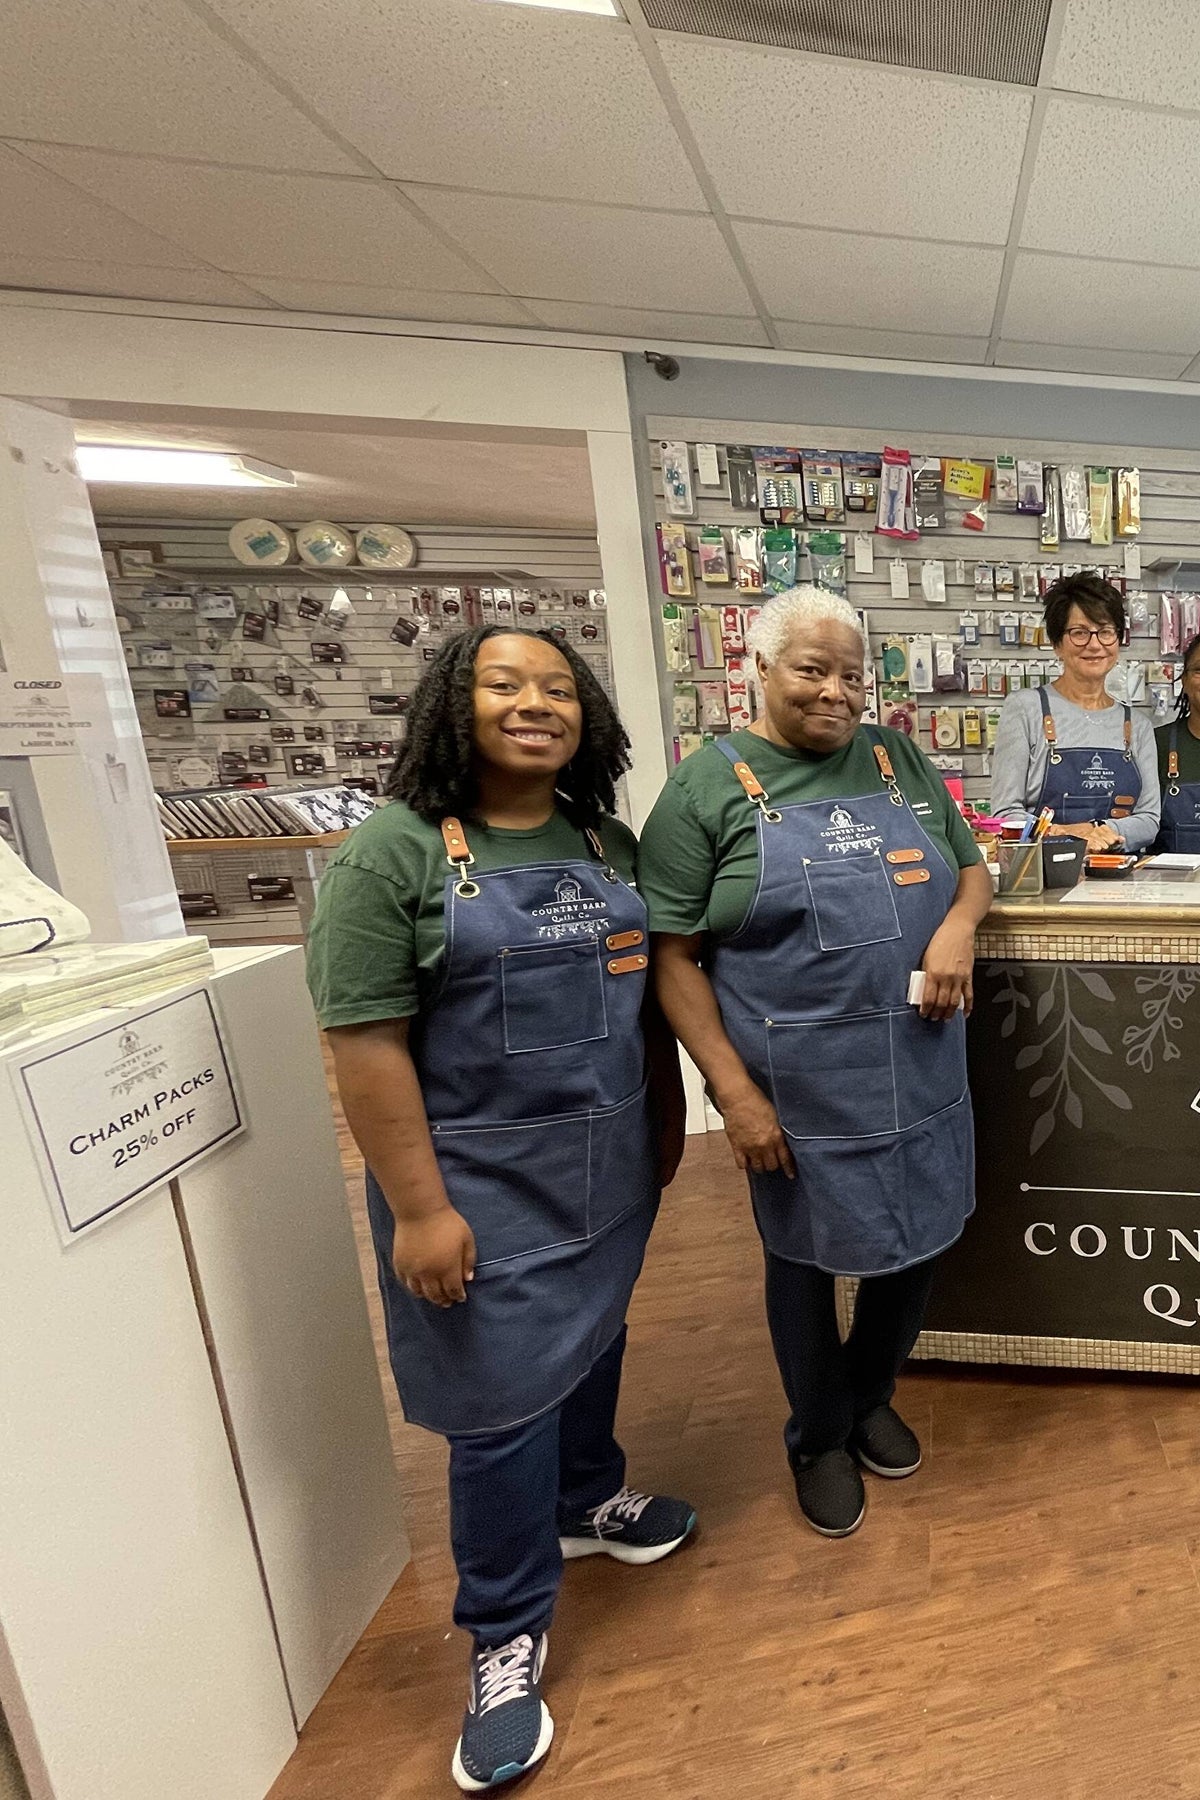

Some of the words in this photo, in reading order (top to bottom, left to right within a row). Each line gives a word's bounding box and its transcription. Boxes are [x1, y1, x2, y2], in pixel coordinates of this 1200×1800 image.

[13, 681, 62, 690] CLOSED
[531, 904, 579, 917] COUNTRY
[582, 901, 607, 910] BARN
[69, 1103, 151, 1157] CHARM
[154, 1068, 215, 1111] PACKS
[112, 1129, 159, 1169] 25%
[162, 1108, 196, 1138] OFF
